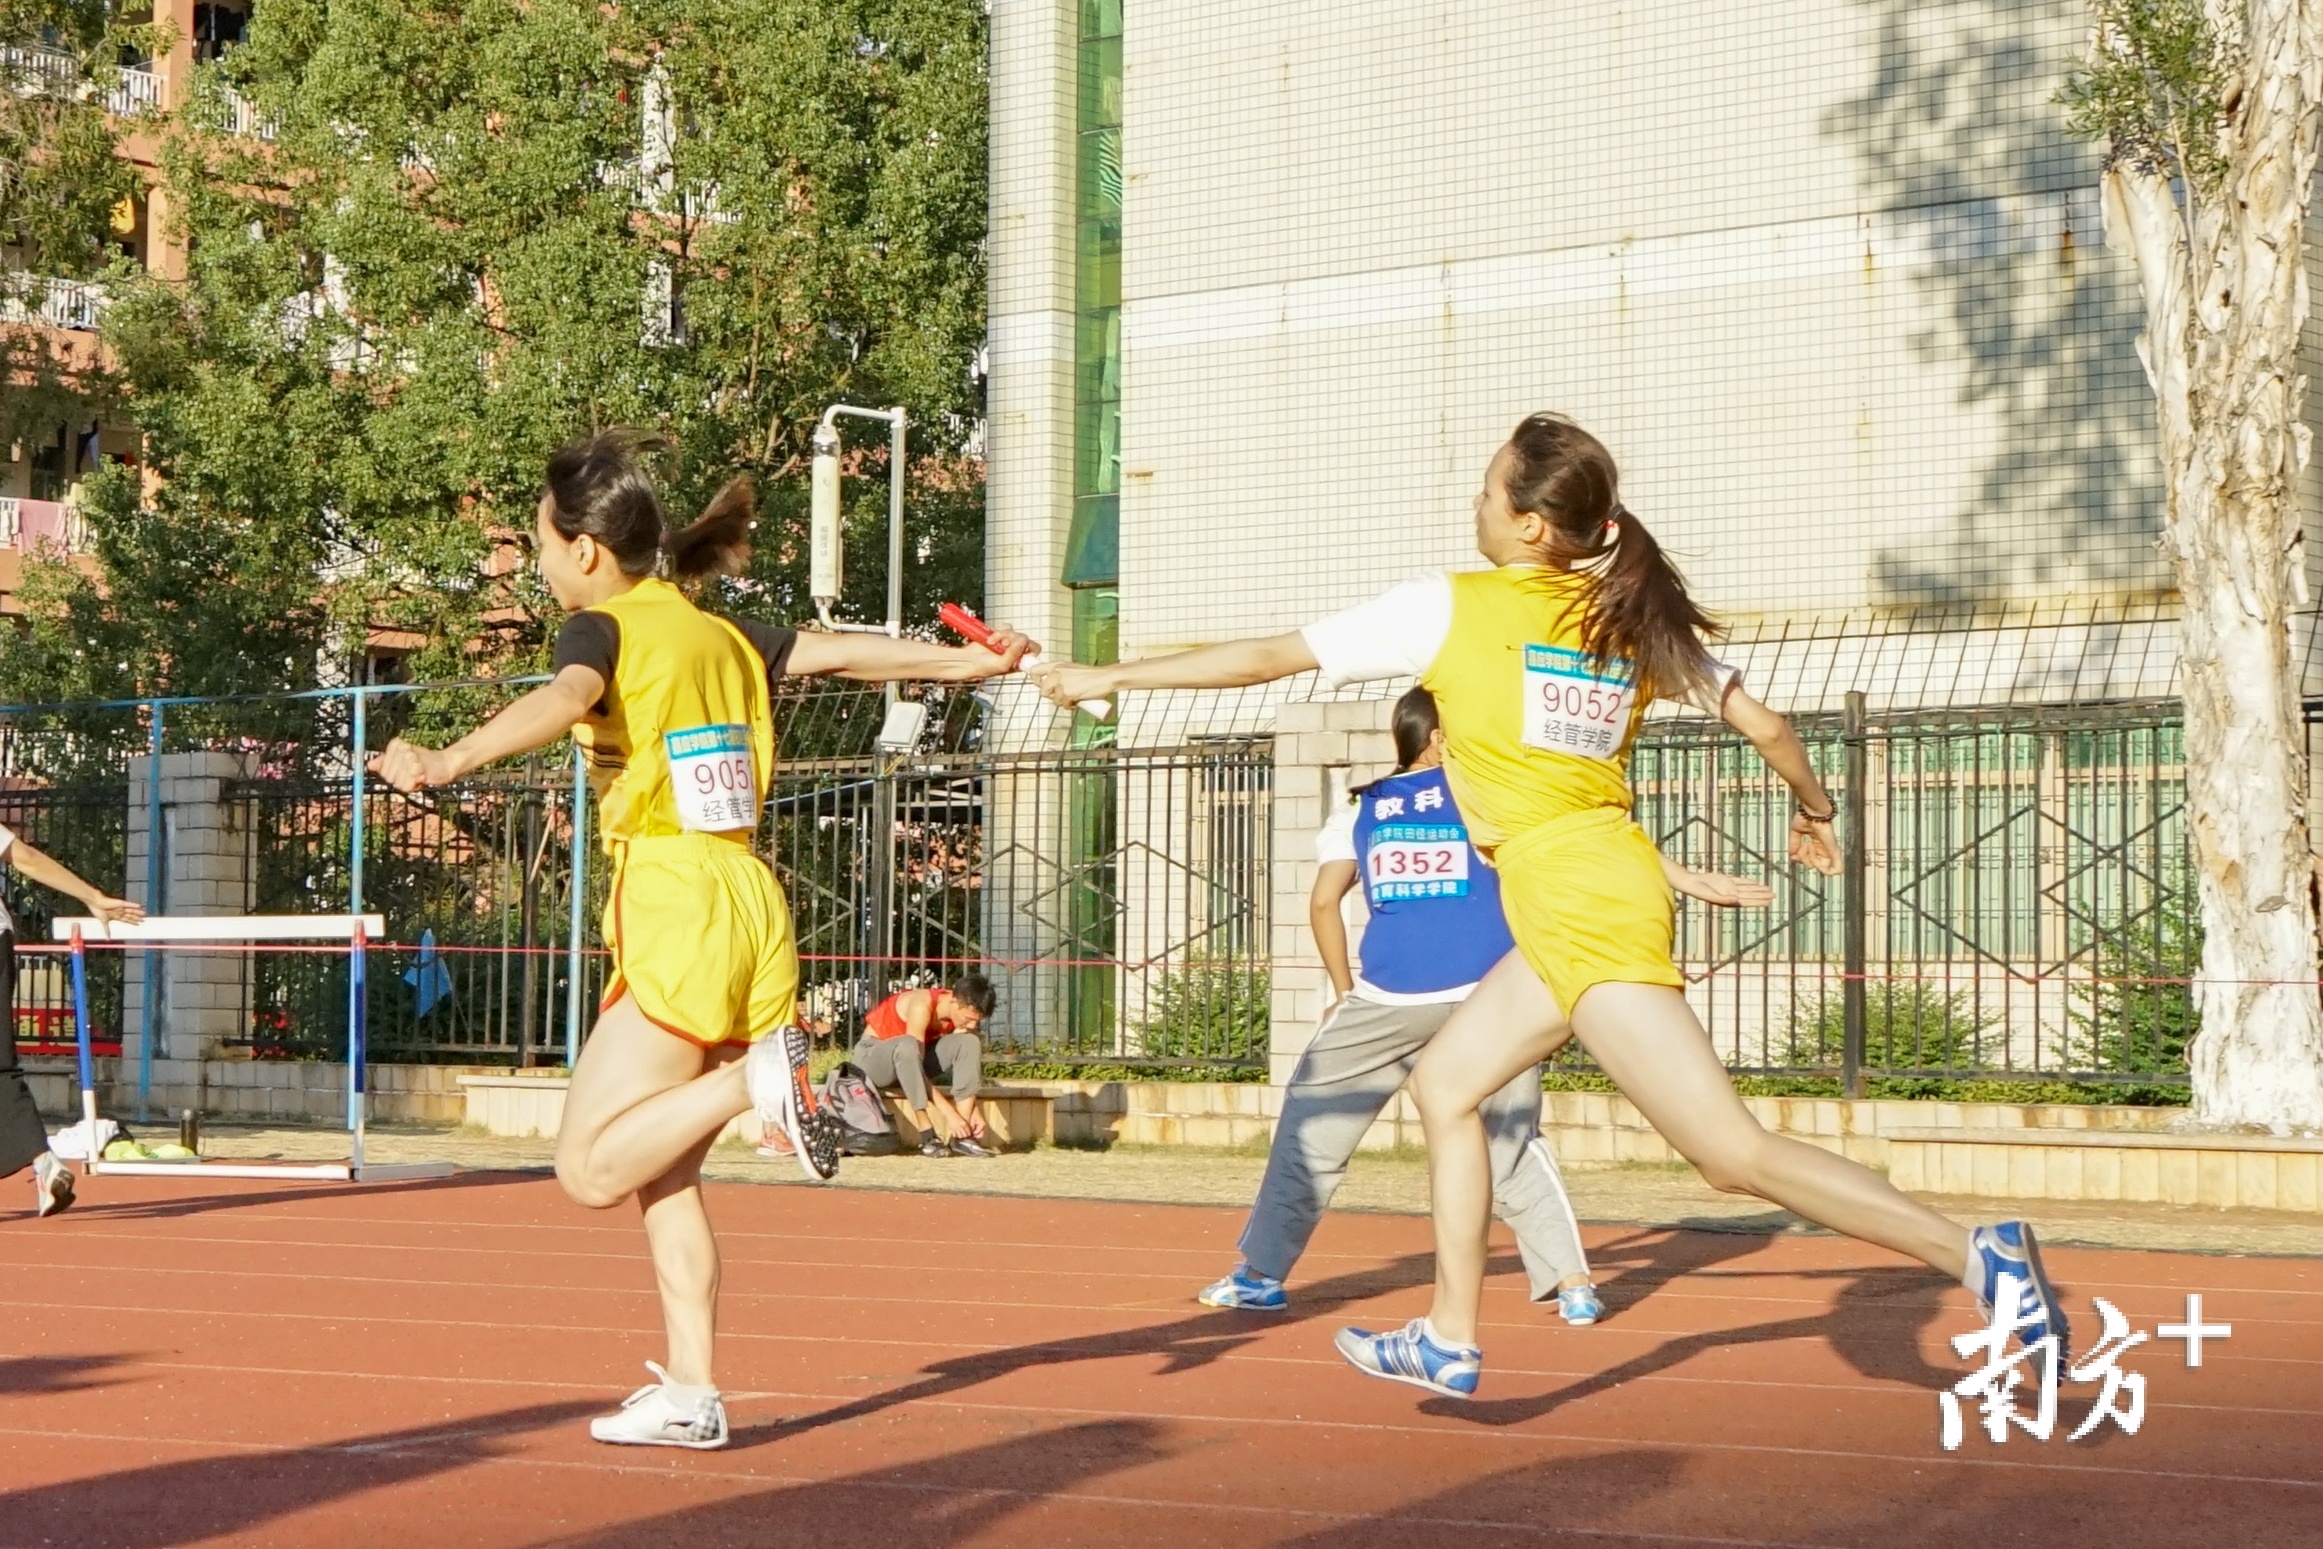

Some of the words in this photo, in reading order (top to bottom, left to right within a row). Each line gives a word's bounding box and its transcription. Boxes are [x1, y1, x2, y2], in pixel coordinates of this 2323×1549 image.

[1543, 682, 1621, 724] 9052
[1543, 718, 1613, 752] 经管学院
[1374, 785, 1444, 820] 教科
[1373, 850, 1453, 876] 1352
